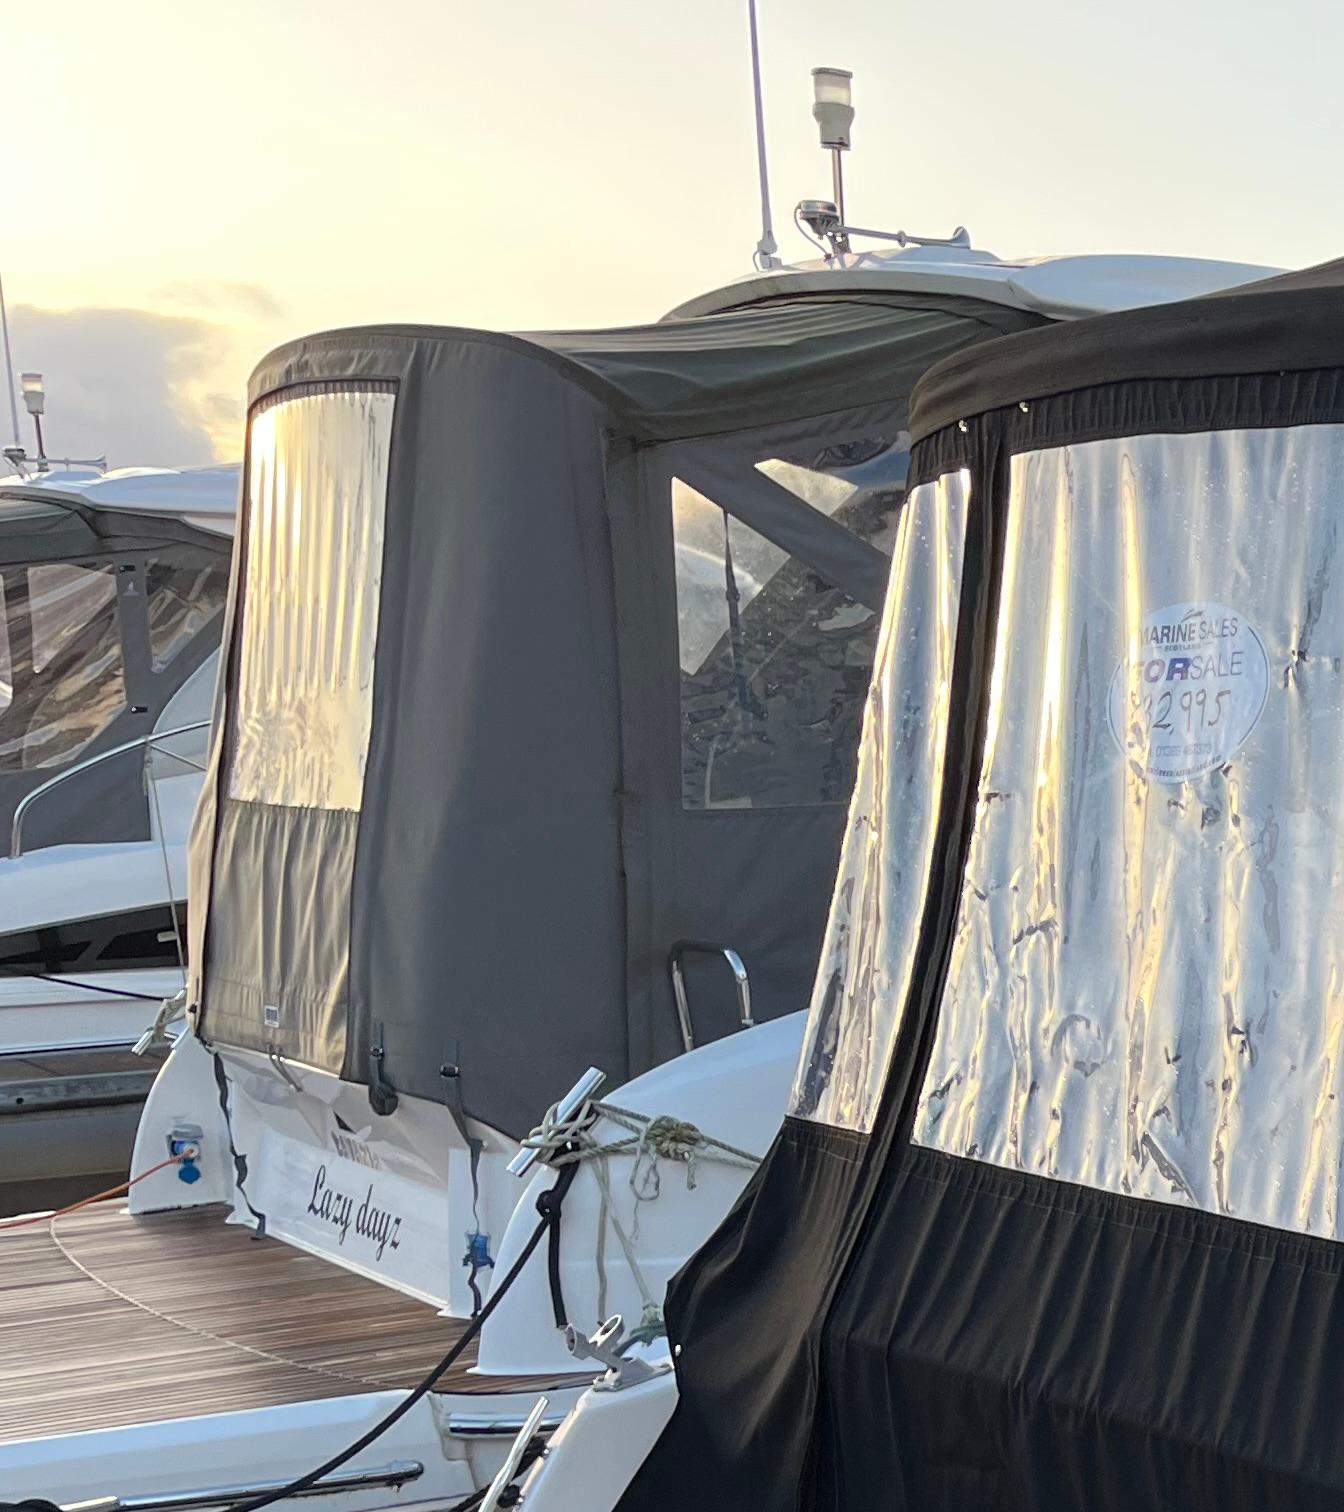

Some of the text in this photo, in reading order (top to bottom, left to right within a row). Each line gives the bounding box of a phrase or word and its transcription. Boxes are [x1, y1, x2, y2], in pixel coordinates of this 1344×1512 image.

[1198, 617, 1239, 641] SALES
[1189, 651, 1245, 680] SALE
[308, 1164, 402, 1262] Lazy dayz
